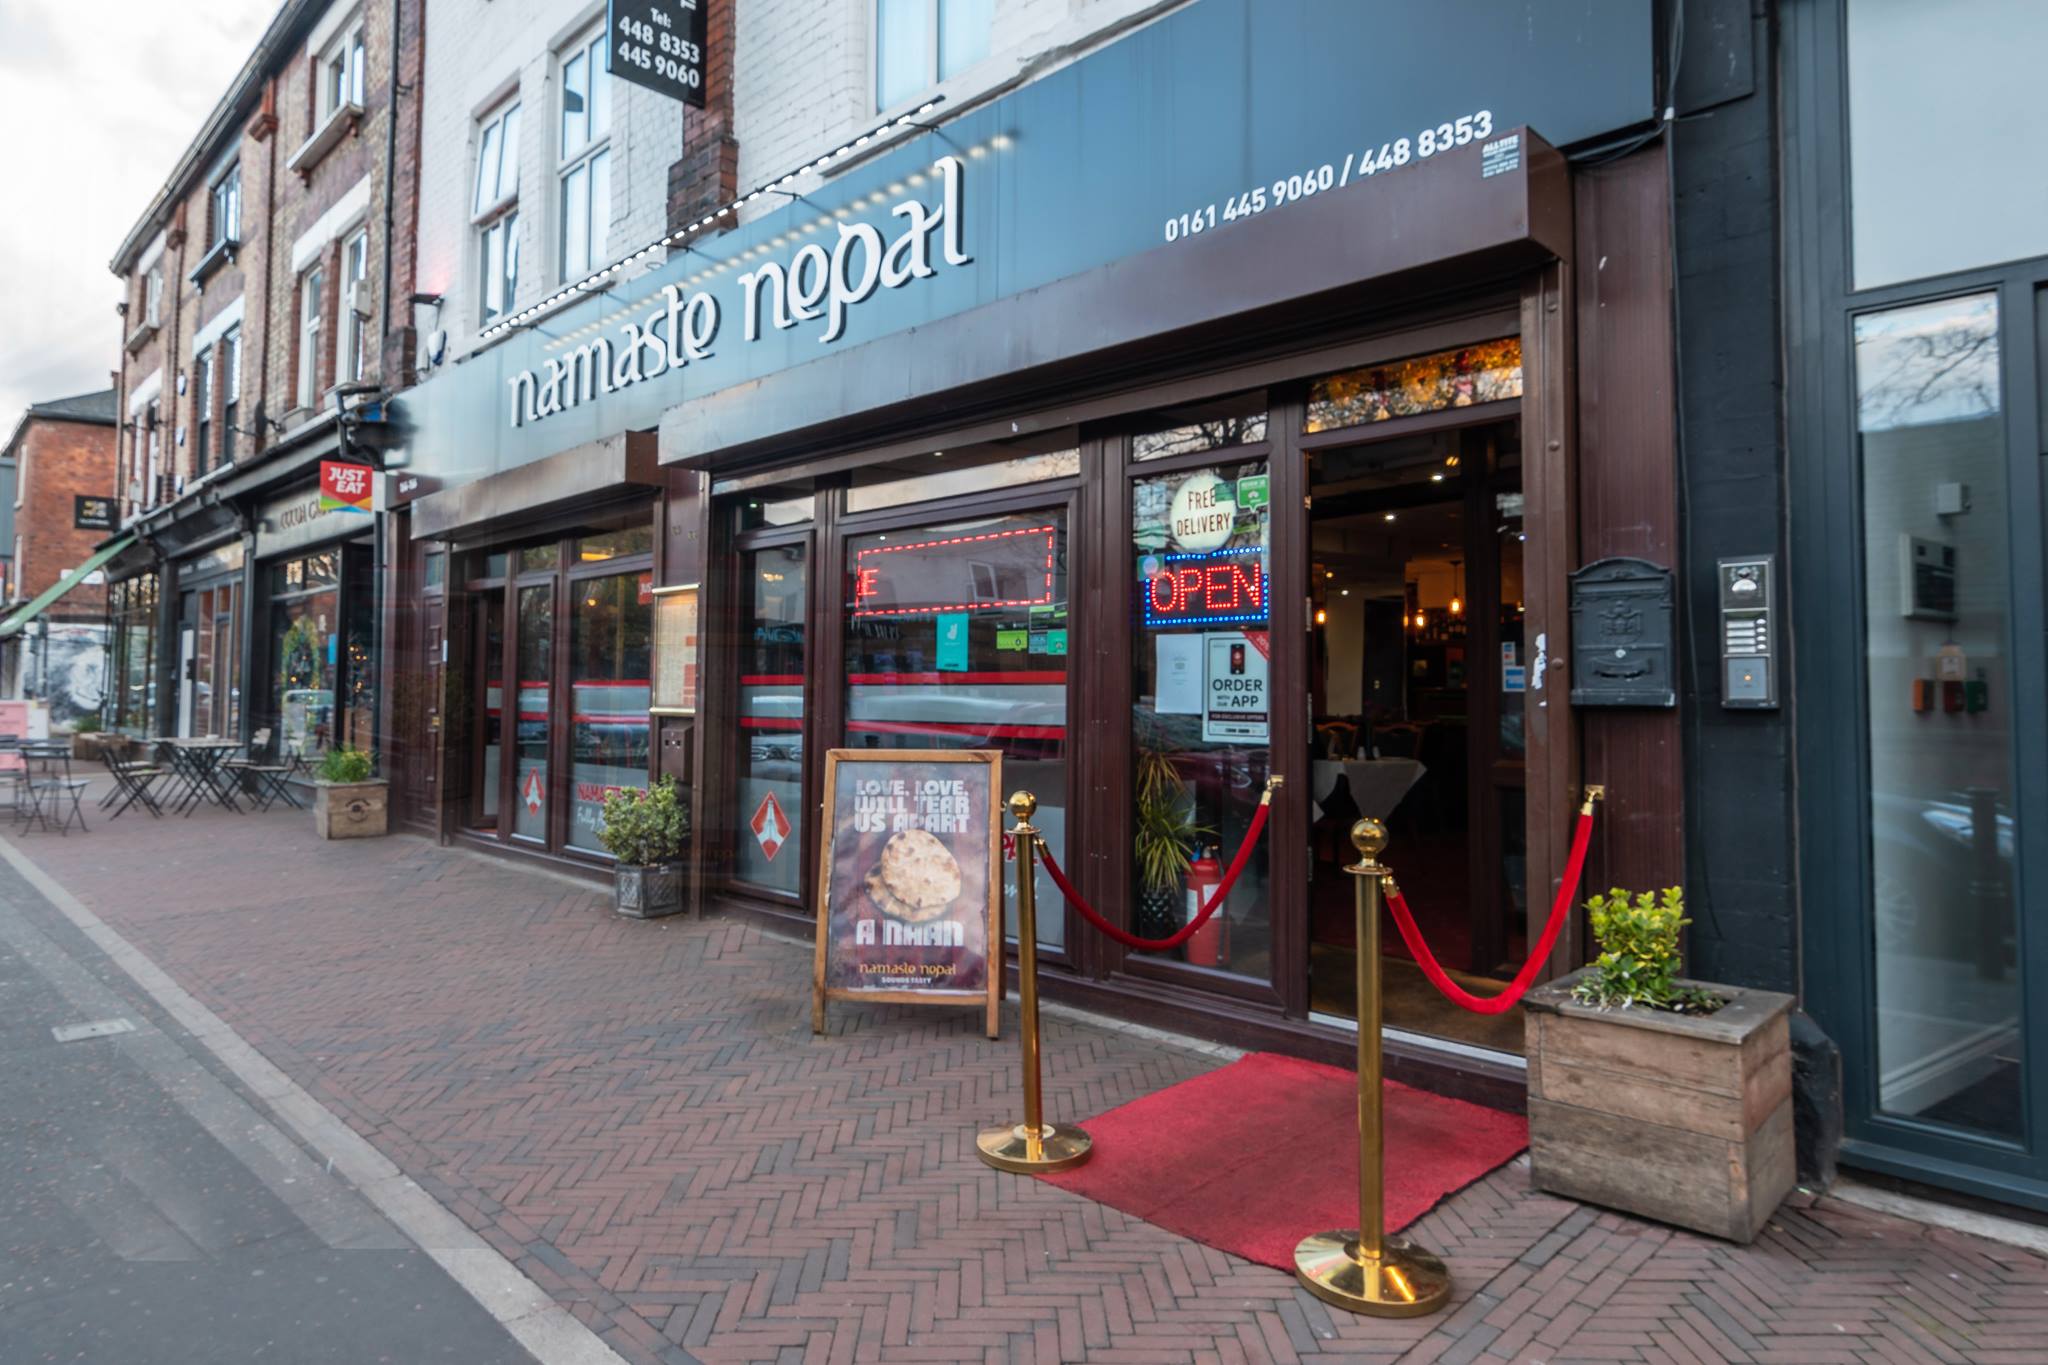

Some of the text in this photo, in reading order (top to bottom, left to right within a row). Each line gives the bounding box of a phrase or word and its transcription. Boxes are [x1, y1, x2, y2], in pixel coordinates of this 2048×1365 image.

[650, 7, 672, 29] Tel:
[618, 15, 700, 64] 448 8353
[618, 41, 700, 89] 445 9060
[1165, 204, 1216, 243] 0161
[1222, 186, 1267, 222] 445
[1272, 165, 1334, 206] 9060
[1358, 137, 1411, 177] 448
[1417, 109, 1494, 158] 8353
[328, 466, 367, 482] JUST
[335, 480, 367, 495] EAT
[1188, 486, 1217, 511] FREE
[1176, 512, 1232, 538] DELIVERY
[1150, 562, 1261, 612] OPEN
[1212, 678, 1263, 692] ORDER
[1231, 694, 1259, 707] APP
[854, 795, 970, 814] WILL TEAR
[854, 812, 970, 833] US APART
[856, 919, 964, 947] A NAAN
